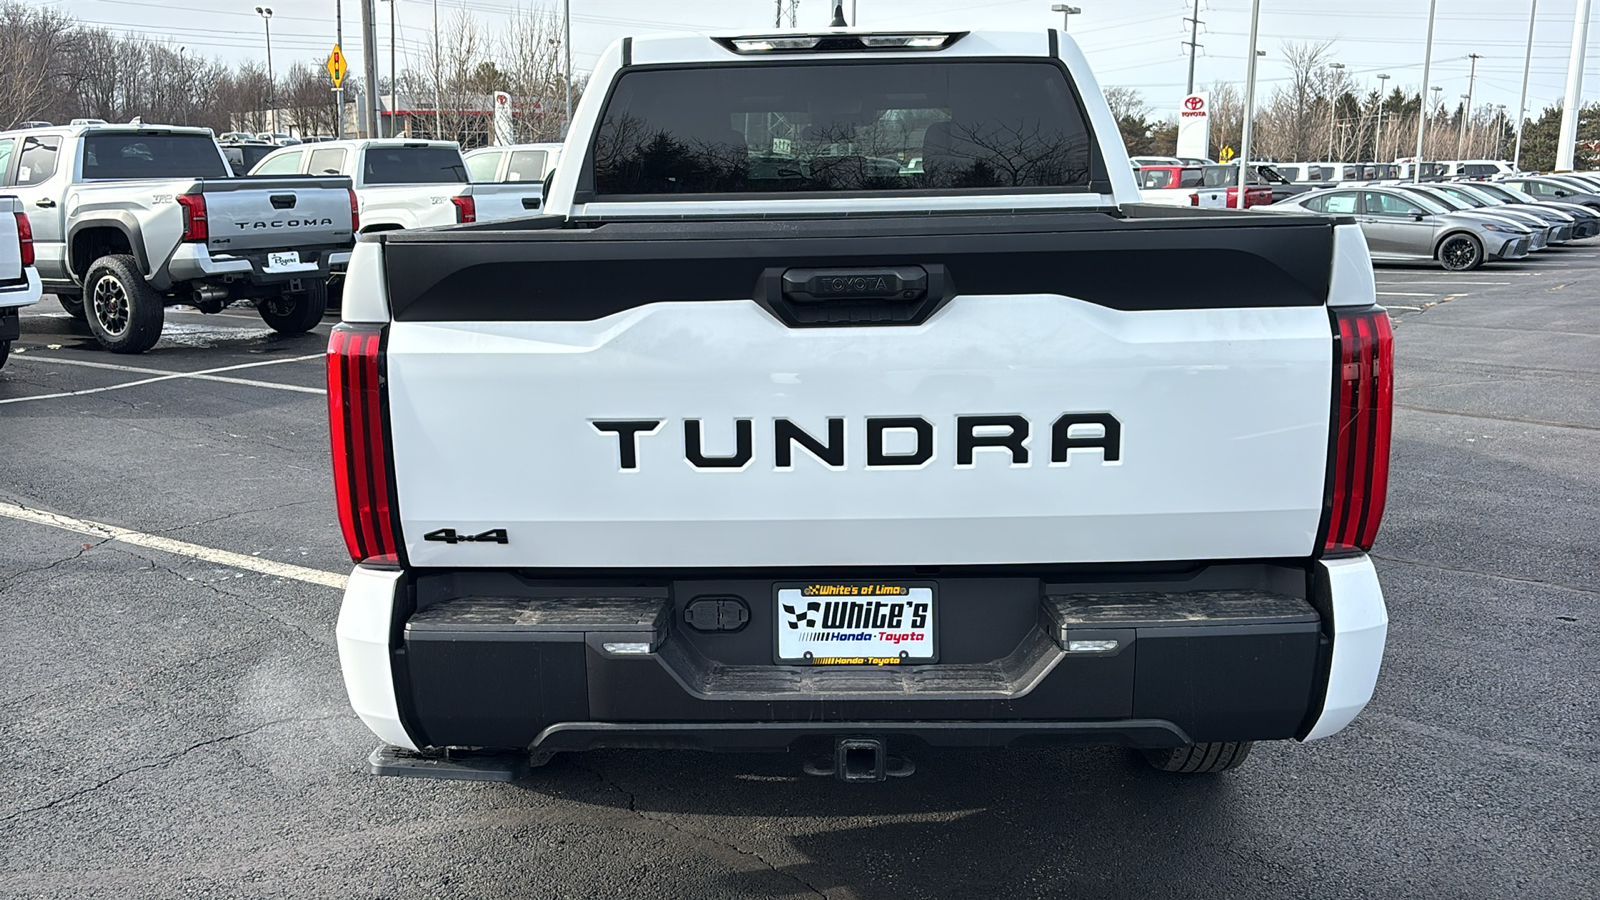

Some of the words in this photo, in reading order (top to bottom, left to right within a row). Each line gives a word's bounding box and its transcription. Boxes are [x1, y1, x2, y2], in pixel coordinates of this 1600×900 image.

[235, 218, 333, 230] TACOMA
[821, 277, 888, 292] TOYOTA
[589, 411, 1123, 471] TUNDRA
[819, 585, 859, 595] White's
[861, 585, 873, 595] of
[875, 585, 901, 595] Lima
[822, 601, 928, 629] White's
[831, 632, 872, 641] Honda
[878, 632, 924, 644] Toyota
[835, 657, 863, 665] Honda
[867, 657, 900, 667] Toyota
